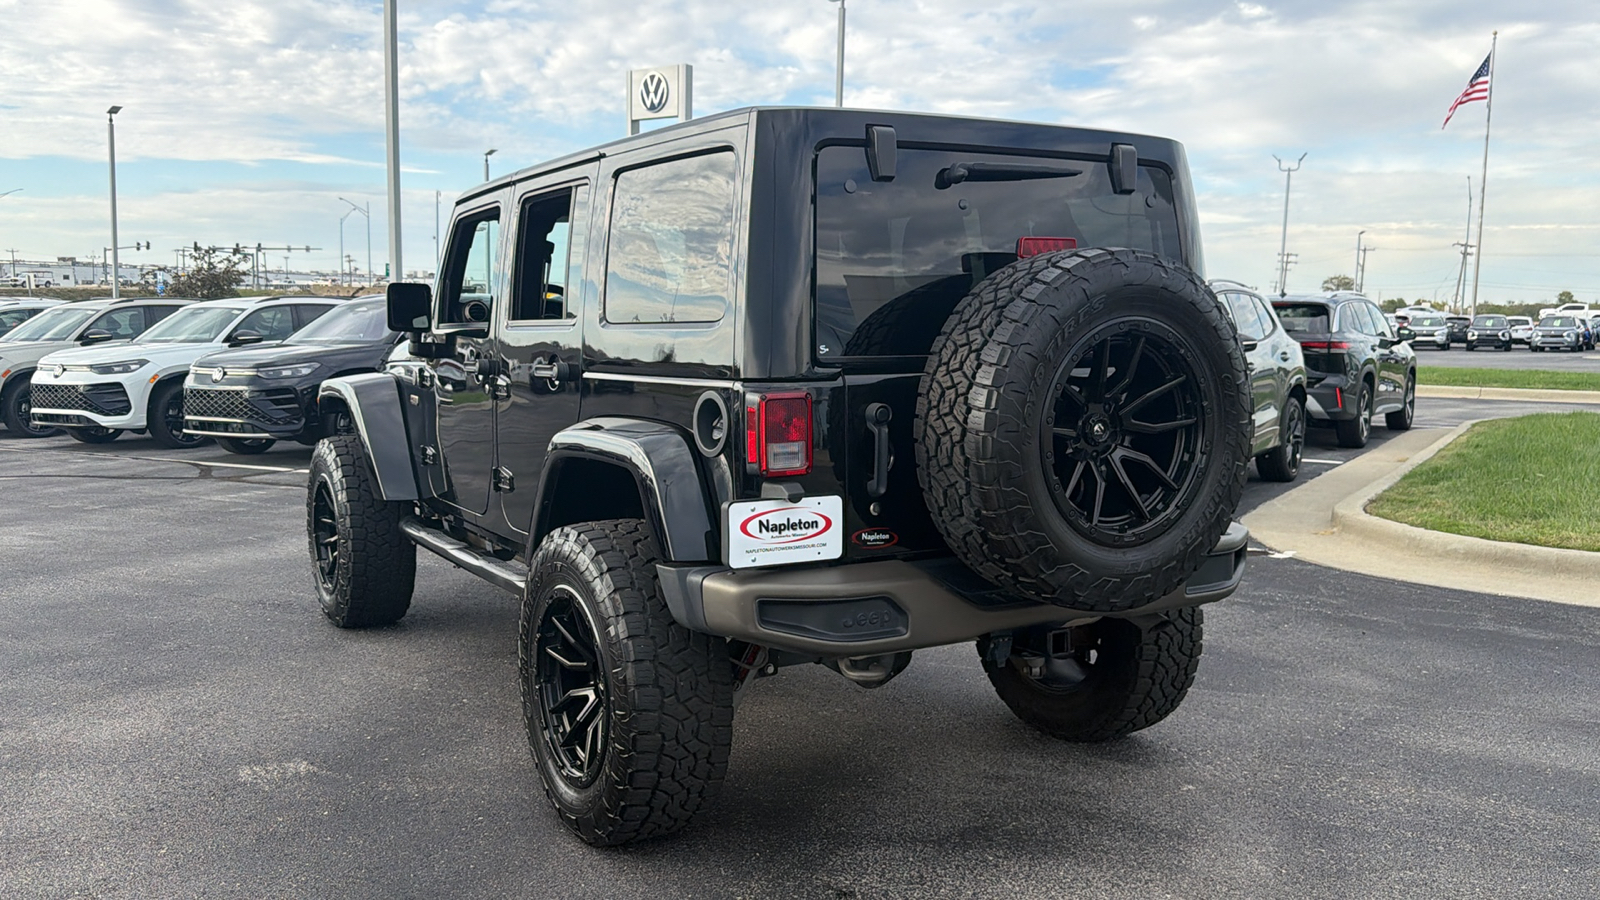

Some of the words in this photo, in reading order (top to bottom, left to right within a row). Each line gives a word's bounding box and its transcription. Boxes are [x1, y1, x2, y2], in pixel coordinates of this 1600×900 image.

[758, 517, 819, 535] Napleton
[861, 532, 890, 542] Napleton
[842, 609, 891, 628] Jeep
